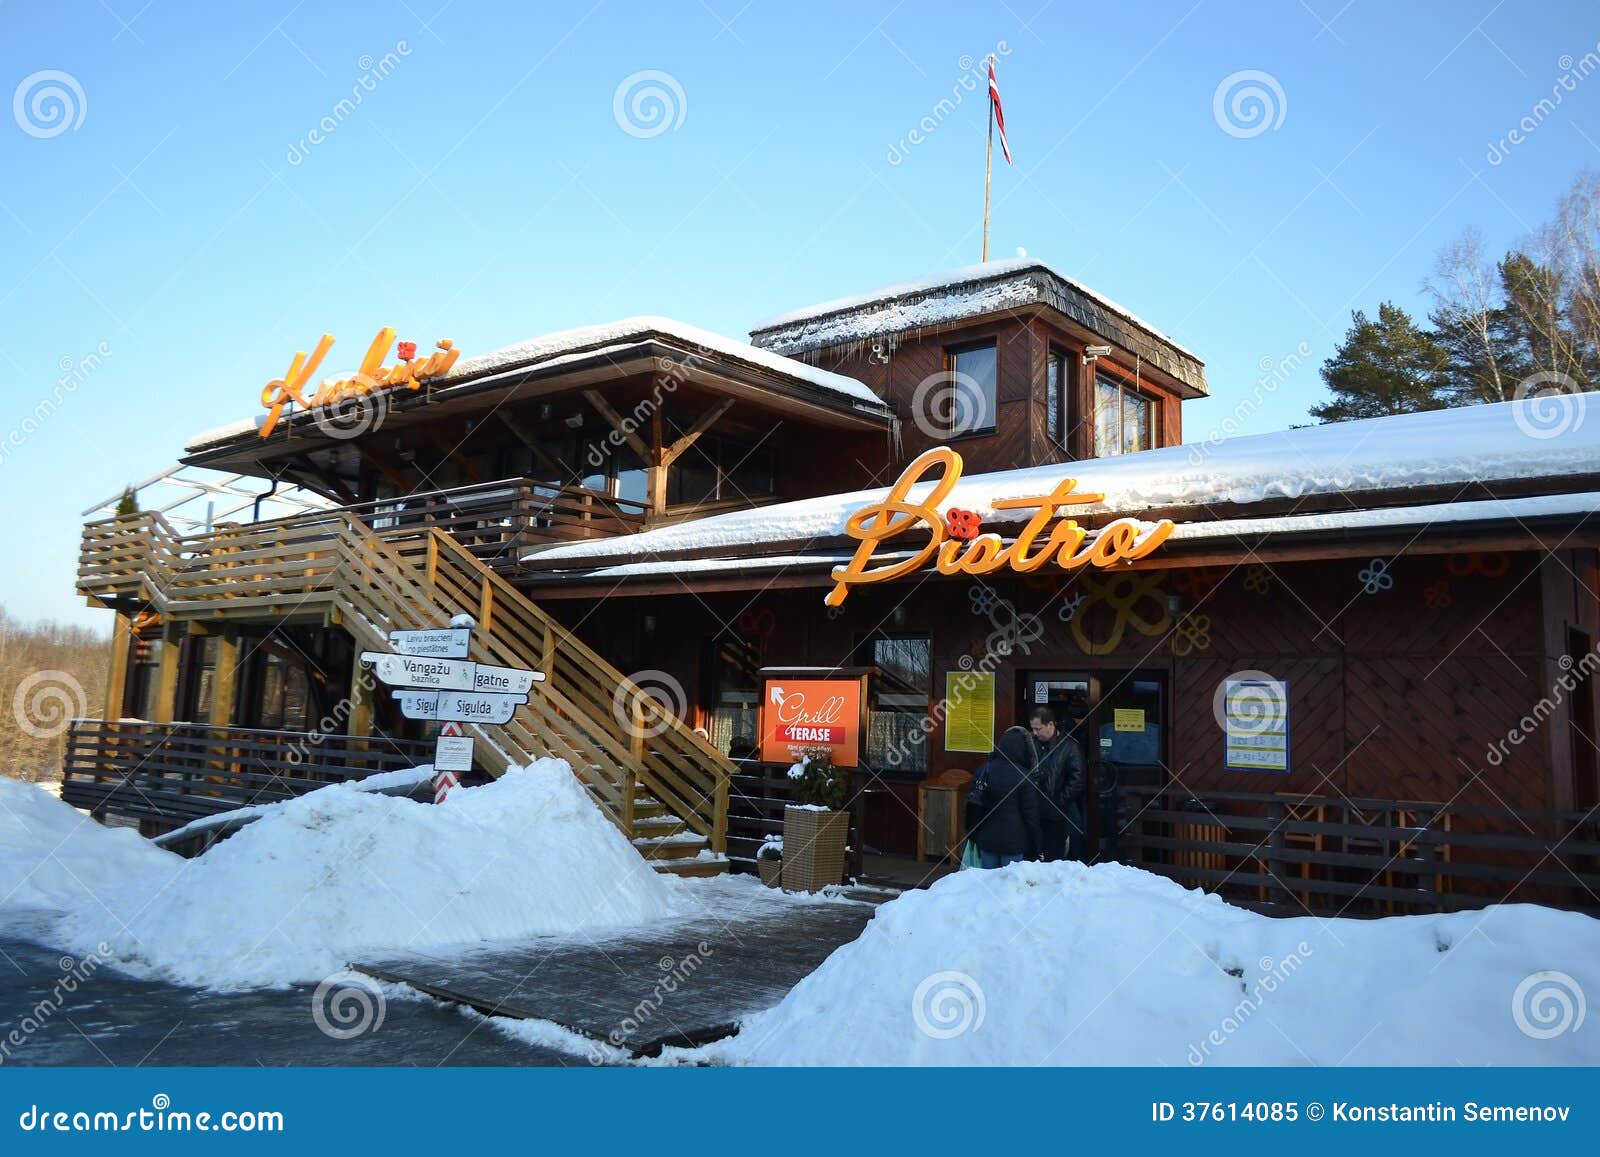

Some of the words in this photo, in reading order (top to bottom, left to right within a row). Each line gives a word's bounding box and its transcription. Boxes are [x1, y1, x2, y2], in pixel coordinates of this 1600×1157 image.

[824, 446, 1175, 607] Bistro
[404, 660, 450, 676] Vangažu
[411, 674, 440, 684] baznīca
[415, 698, 438, 714] Sigul
[456, 699, 492, 715] Sigulda
[778, 692, 845, 736] Grill
[790, 727, 831, 742] TERASE
